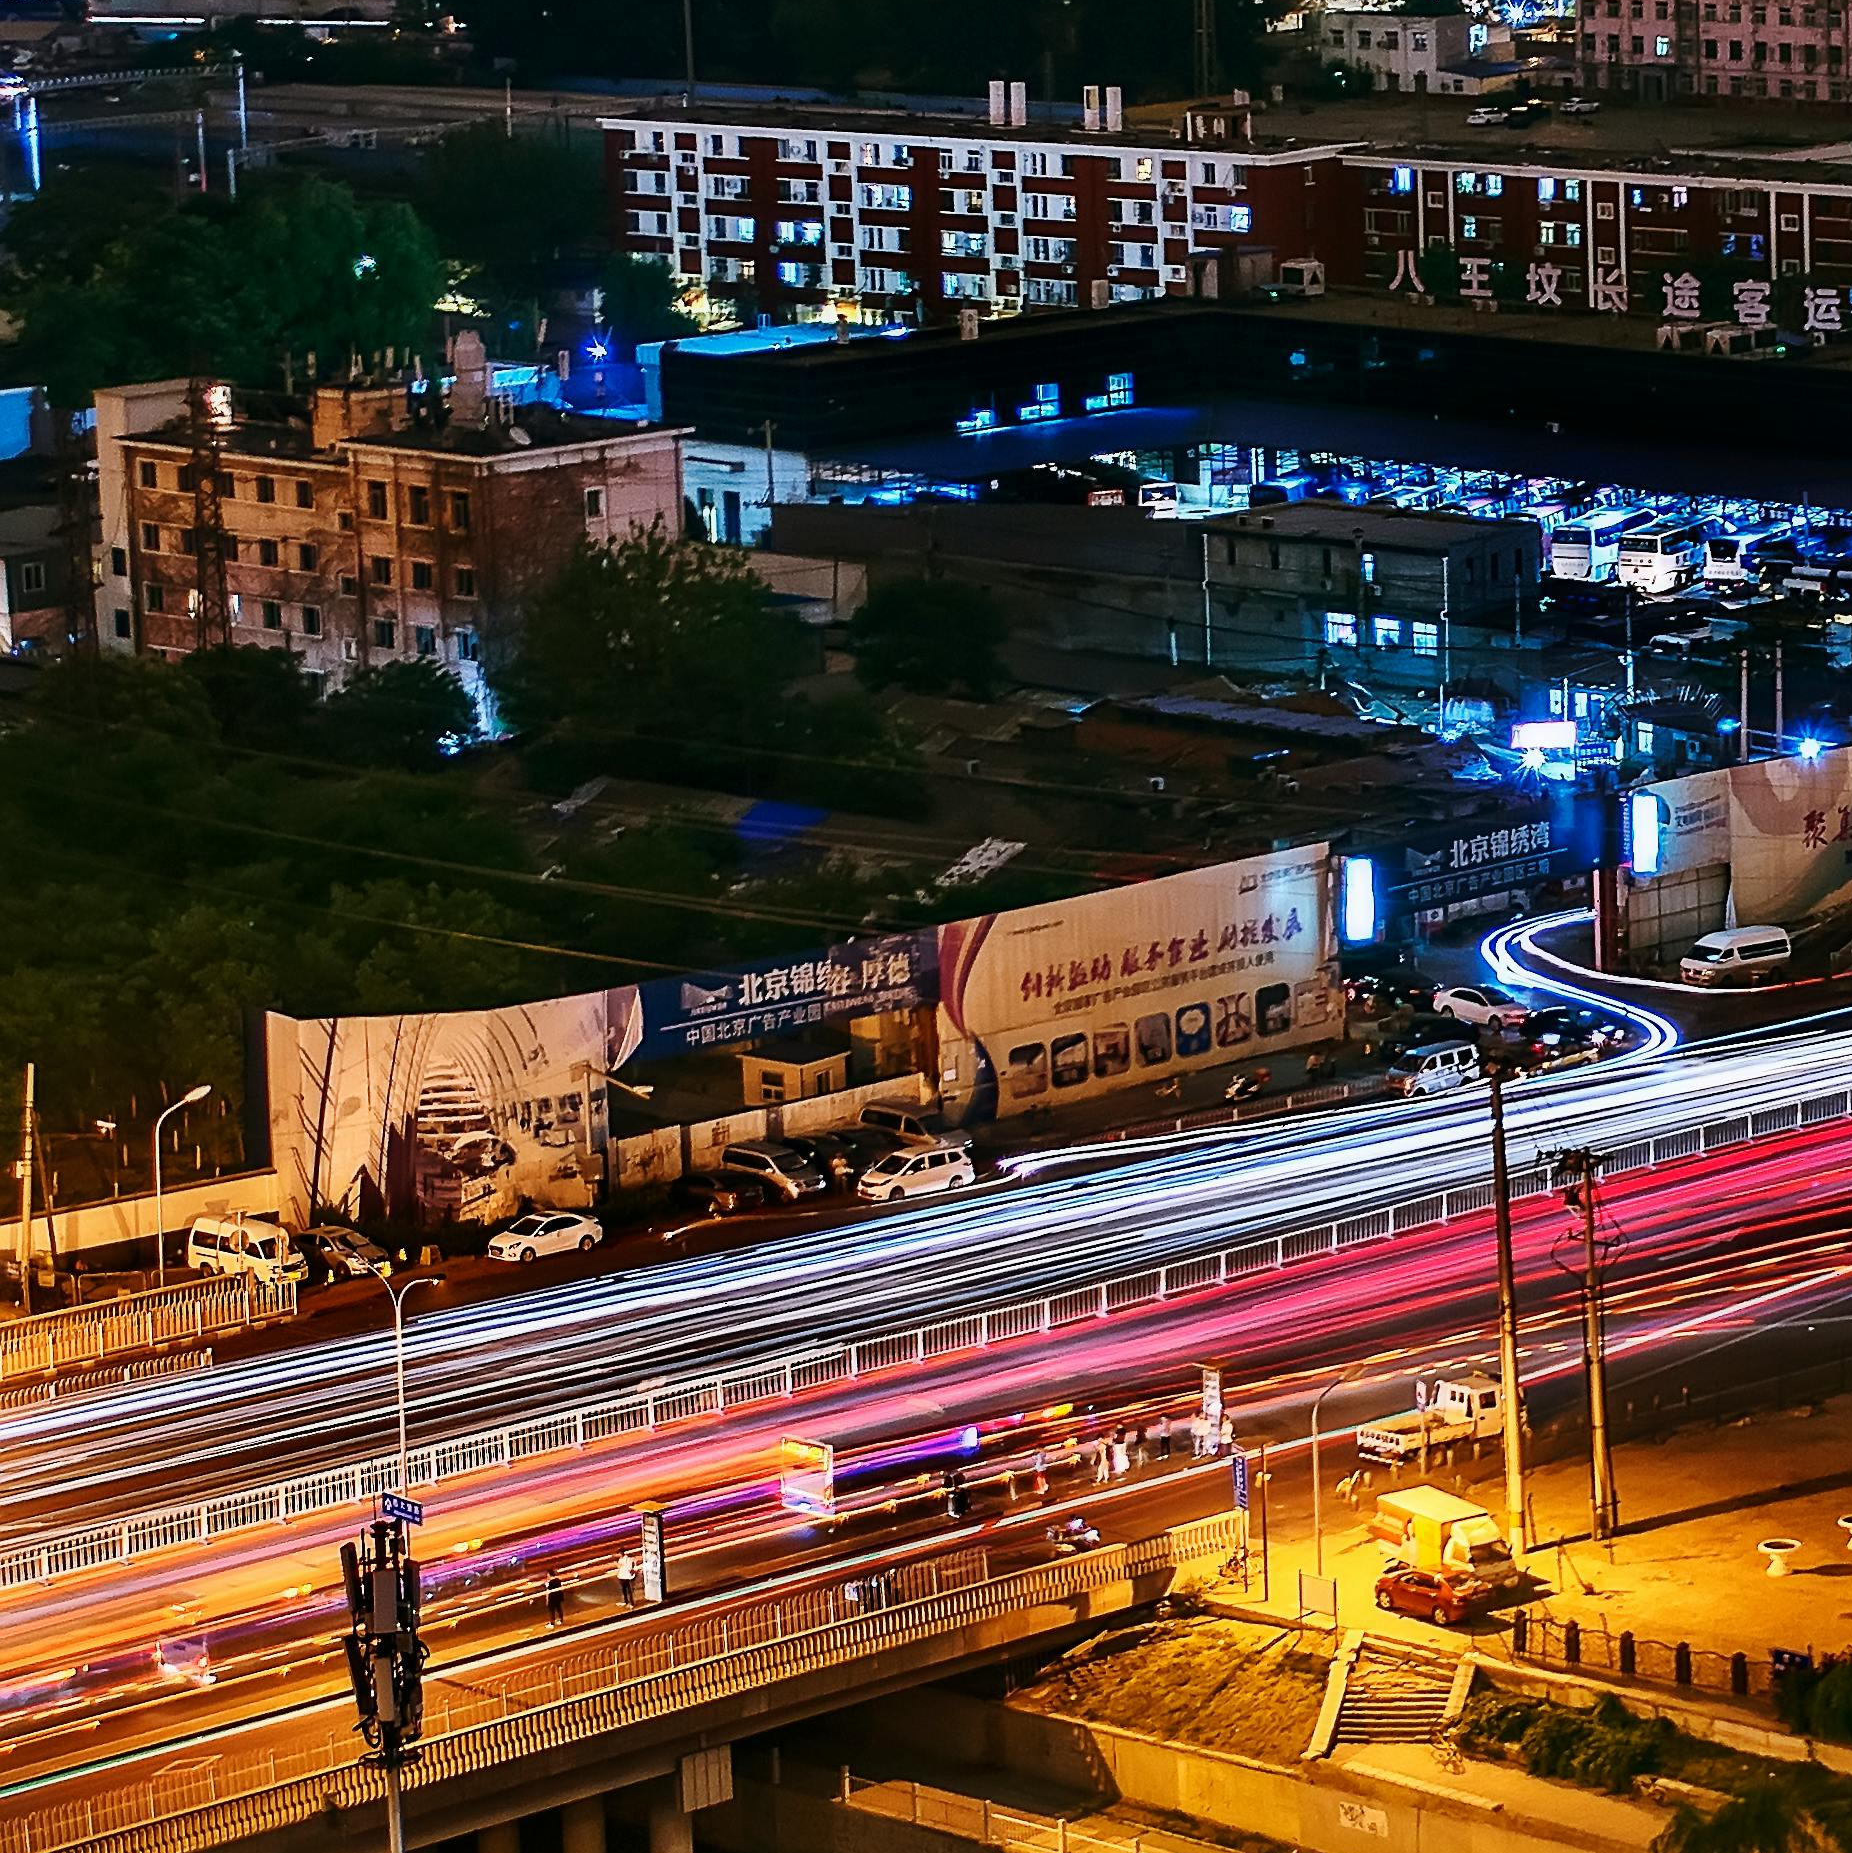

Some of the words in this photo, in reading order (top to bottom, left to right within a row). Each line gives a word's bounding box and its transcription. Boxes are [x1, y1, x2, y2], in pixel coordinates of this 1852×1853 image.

[1449, 821, 1550, 868] 北京锦绣湾
